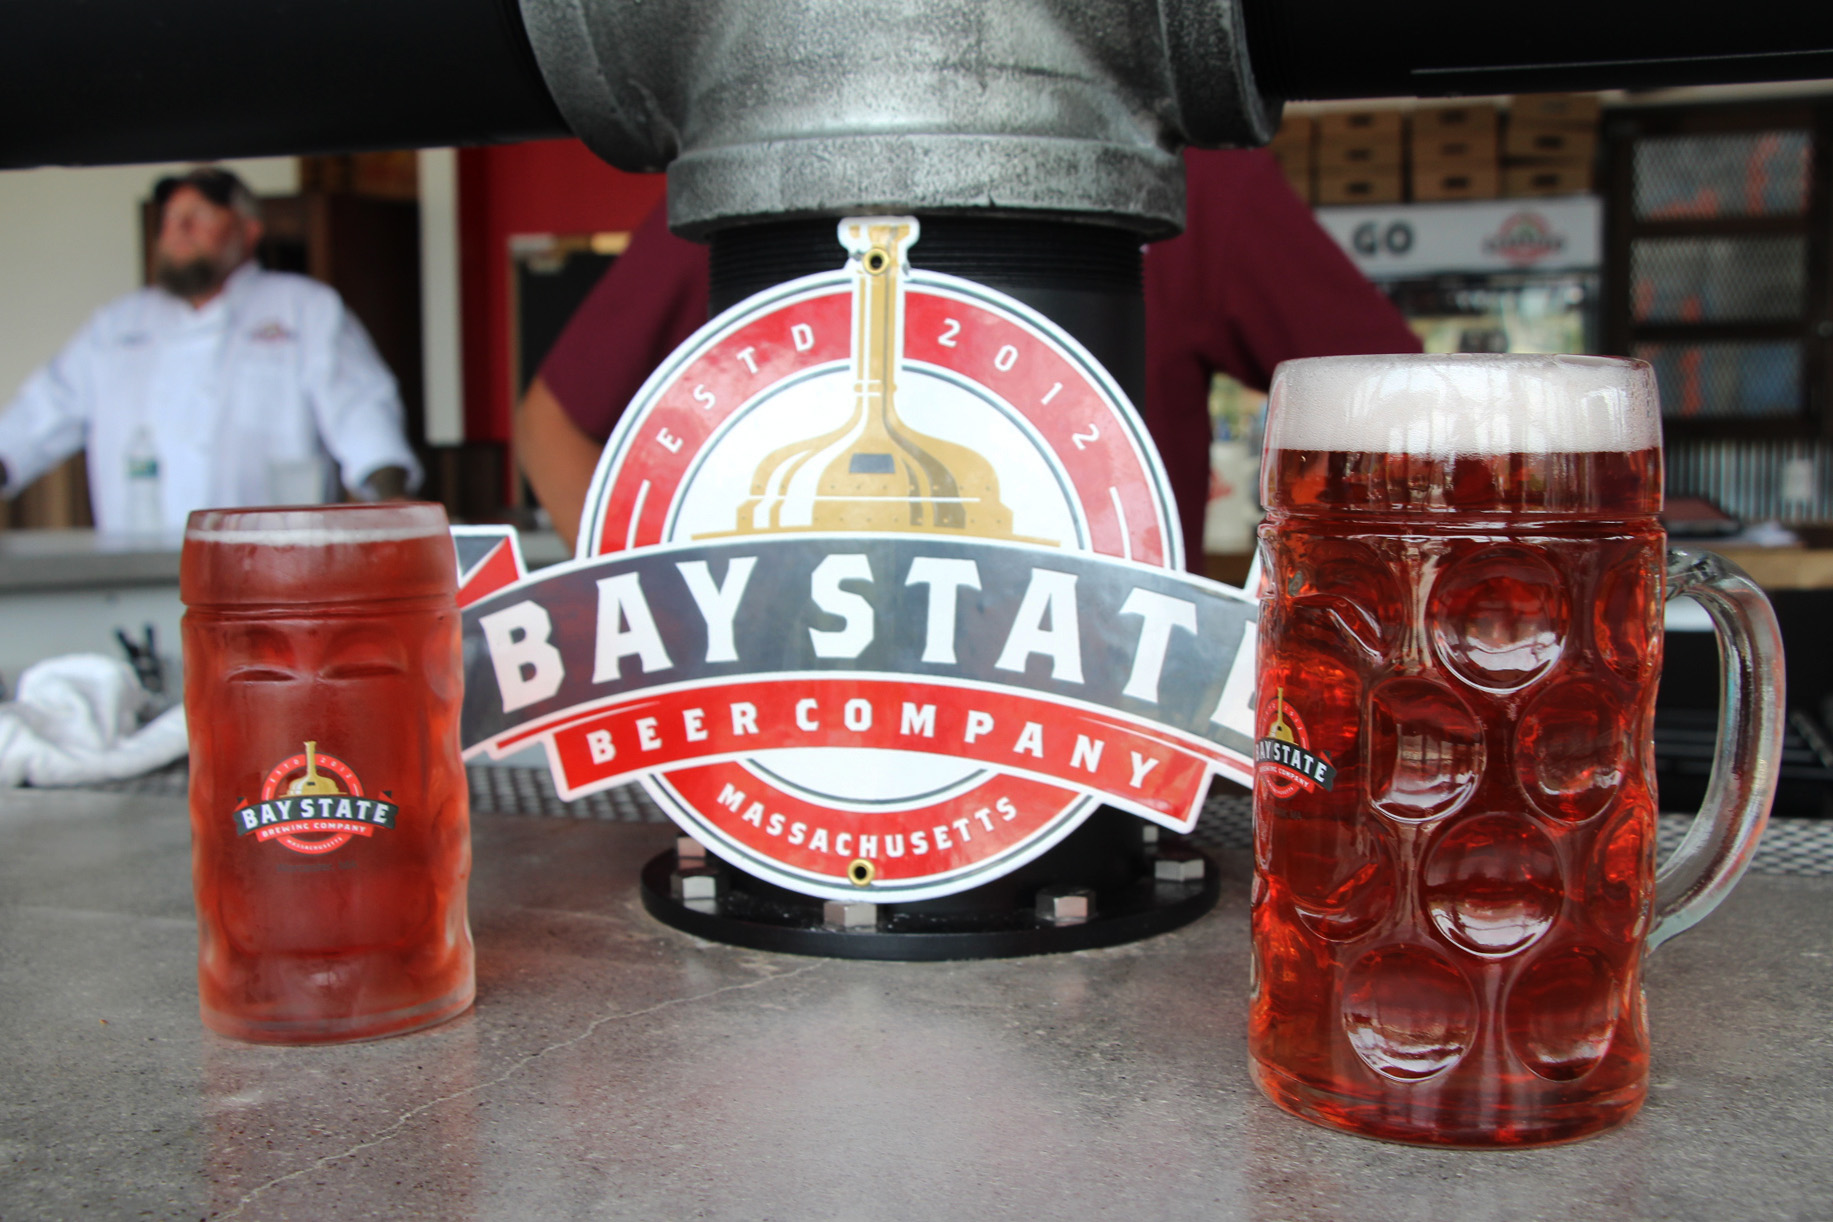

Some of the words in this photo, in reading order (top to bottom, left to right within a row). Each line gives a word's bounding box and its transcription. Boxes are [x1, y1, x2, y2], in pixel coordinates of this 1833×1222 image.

[1352, 221, 1414, 256] GO
[656, 322, 816, 454] ESTD
[937, 317, 1100, 453] 2012
[478, 556, 759, 714] BAY
[585, 701, 760, 766] BEER
[794, 697, 1161, 790] COMPANY
[1273, 742, 1328, 783] STATE
[241, 799, 292, 830] BAY
[300, 798, 390, 824] STATE
[262, 822, 310, 838] BREWING
[313, 822, 367, 834] COMPANY
[715, 781, 1018, 859] MASSACHUSETTS
